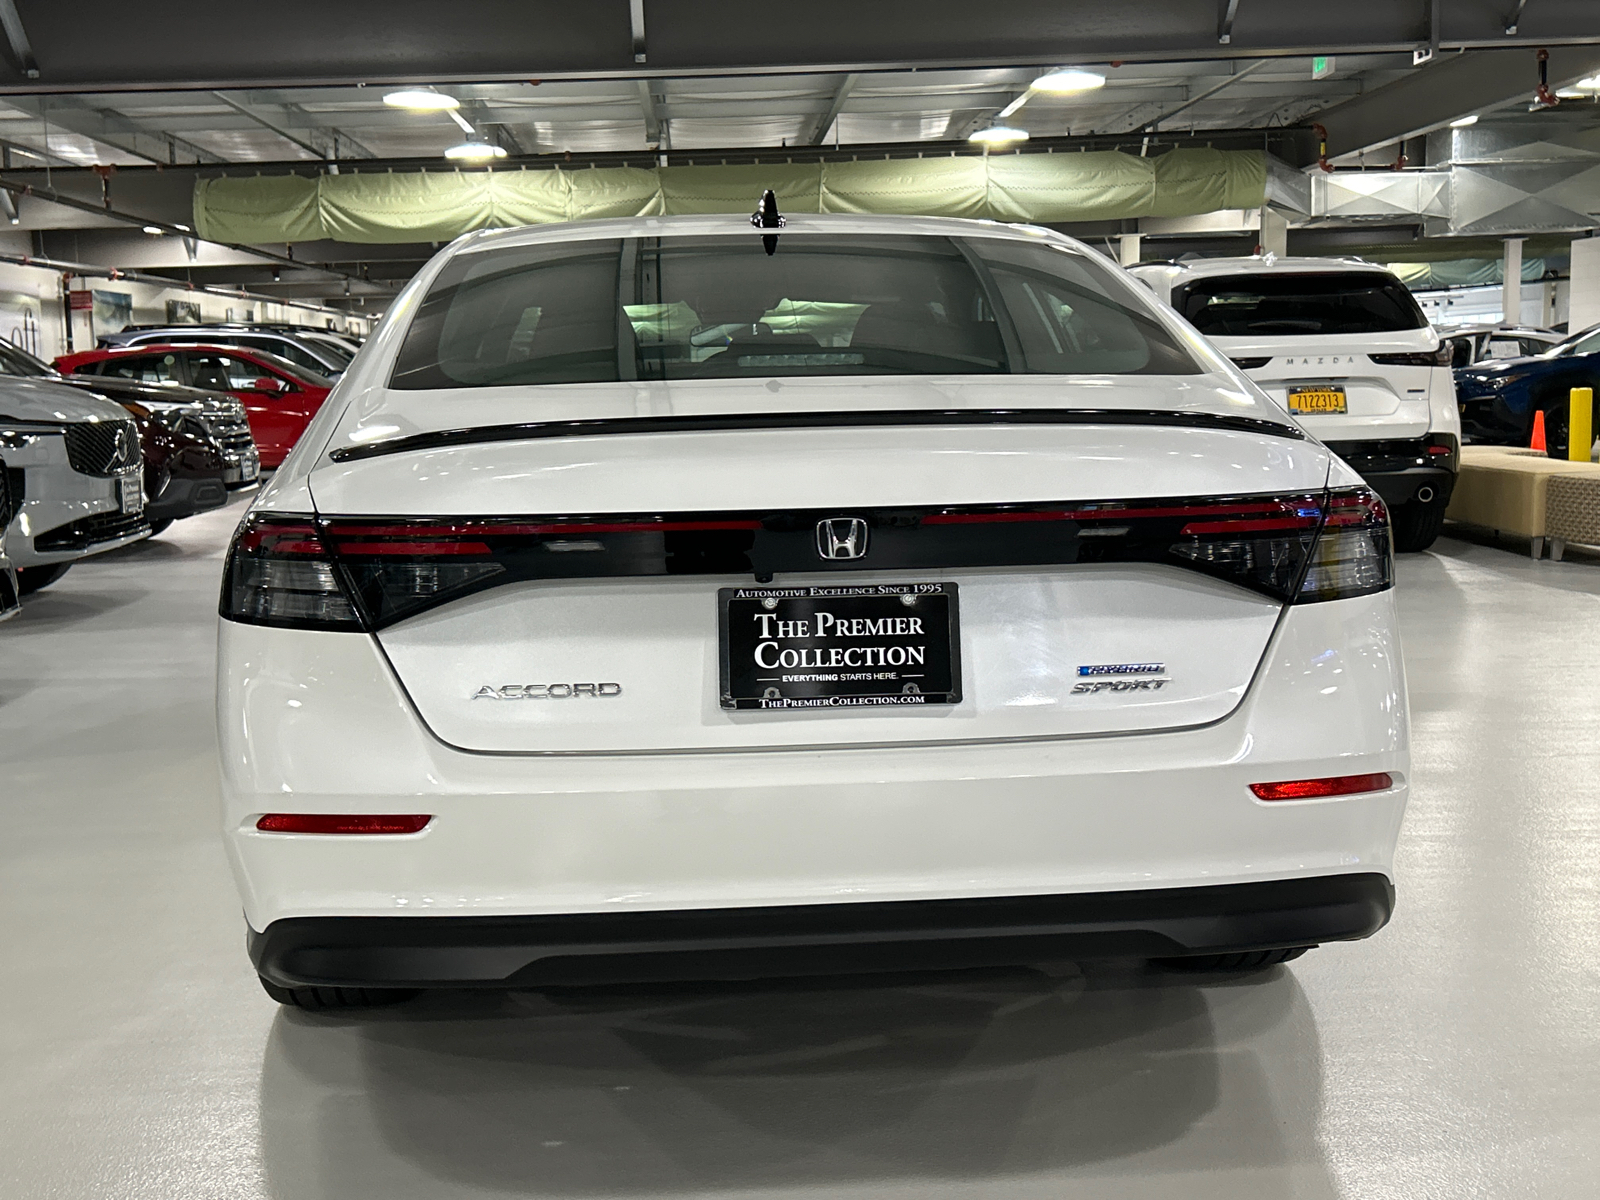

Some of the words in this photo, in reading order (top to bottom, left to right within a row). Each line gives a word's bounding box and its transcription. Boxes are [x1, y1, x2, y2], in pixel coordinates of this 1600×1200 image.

[1286, 356, 1354, 365] MAZDA
[1296, 394, 1339, 408] 7122313
[736, 589, 807, 598] AUTOMOTIVE
[809, 587, 876, 596] EXCELLENCE
[877, 585, 911, 594] SINCE
[913, 584, 942, 593] 1995
[754, 613, 810, 638] THE
[814, 612, 925, 638] PREMIER
[754, 641, 926, 669] COLLECTION
[782, 674, 838, 682] EVERYTHING
[840, 673, 872, 681] STARTS
[873, 672, 899, 680] HERE.
[471, 682, 622, 700] ACCORD
[1070, 678, 1172, 694] SPORT
[759, 695, 925, 708] THEPREMIERCOLLECTION.COM
